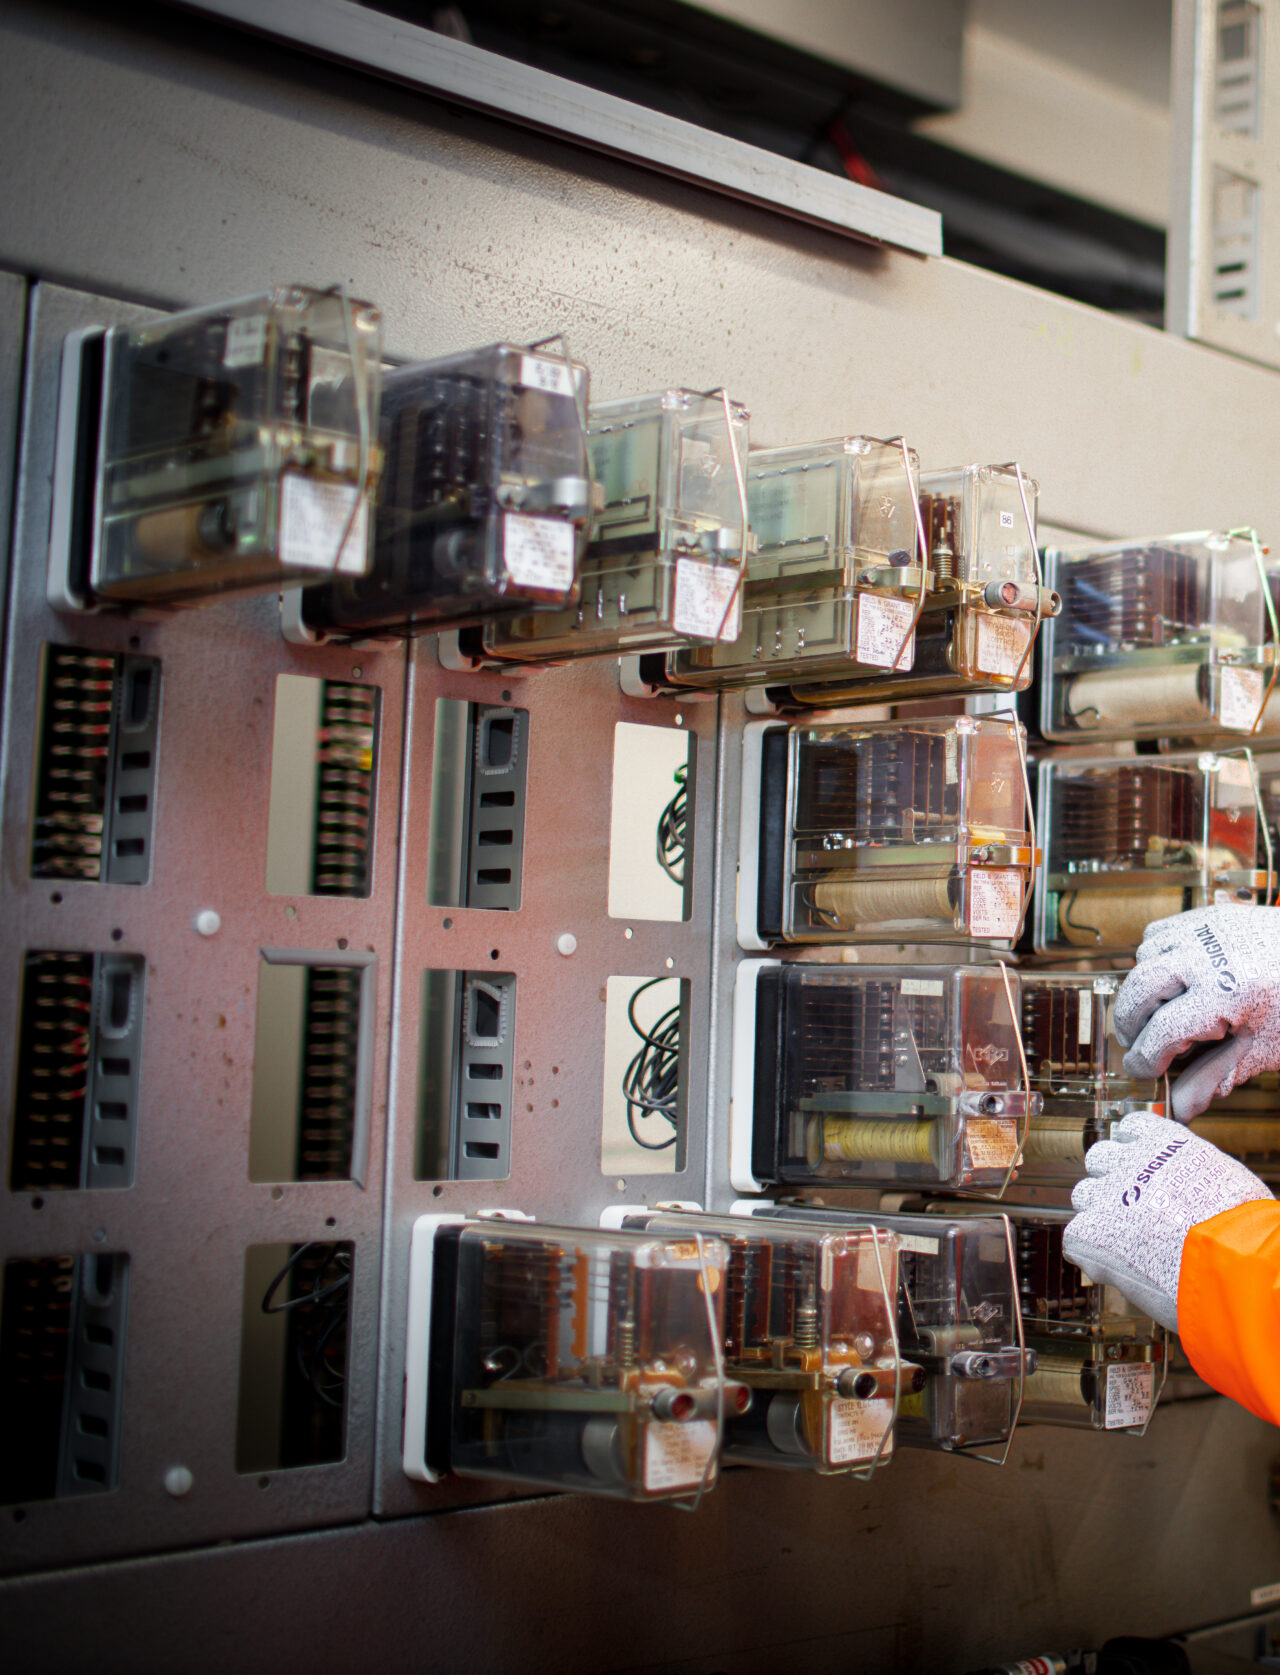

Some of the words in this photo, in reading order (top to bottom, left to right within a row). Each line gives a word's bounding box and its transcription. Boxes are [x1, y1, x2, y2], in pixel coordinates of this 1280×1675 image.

[1002, 514, 1012, 525] 86
[1193, 922, 1229, 969] SIGNAL
[1236, 934, 1252, 955] EDGE
[1136, 1138, 1190, 1185] SIGNAL
[1169, 1165, 1195, 1189] EDGE
[1191, 1149, 1211, 1168] CUT
[1207, 1190, 1225, 1209] SIZE
